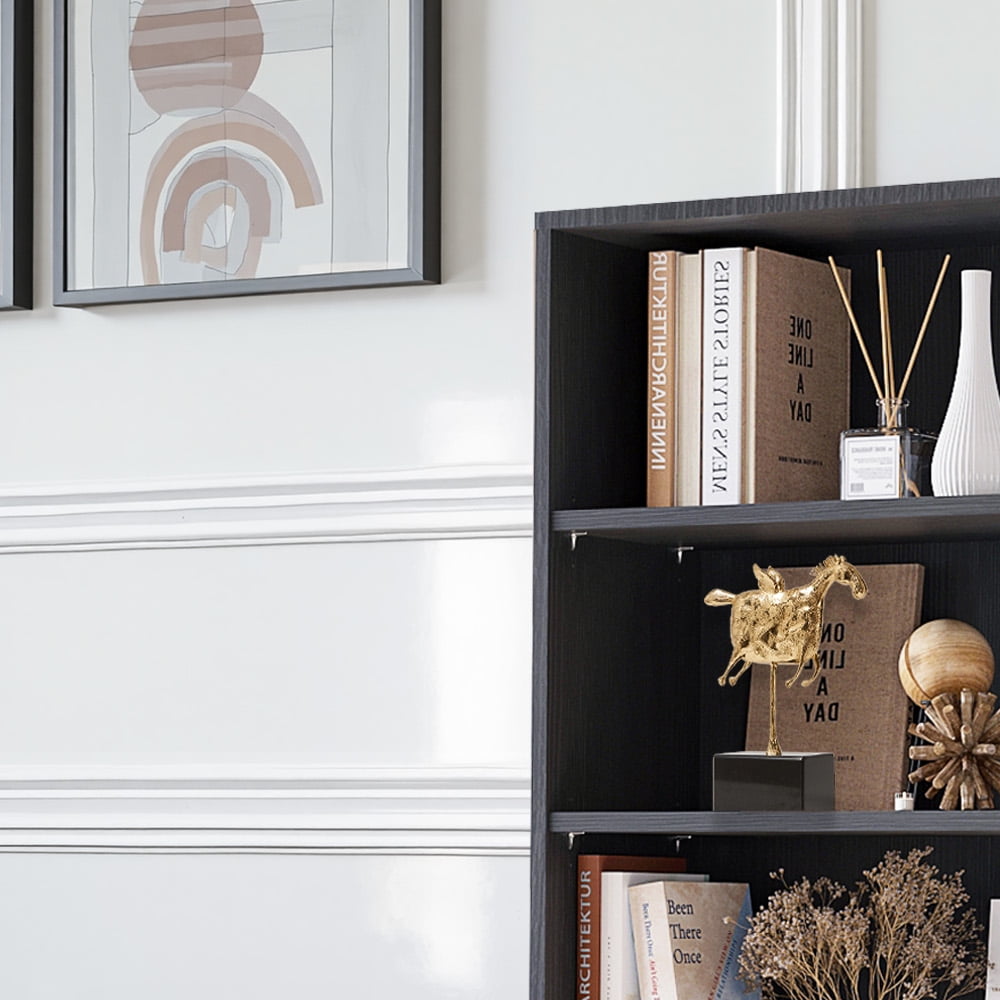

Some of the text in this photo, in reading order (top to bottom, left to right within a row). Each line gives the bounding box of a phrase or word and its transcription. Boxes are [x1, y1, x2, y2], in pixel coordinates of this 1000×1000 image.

[668, 900, 694, 916] Been
[669, 924, 702, 940] There
[673, 949, 702, 965] Once
